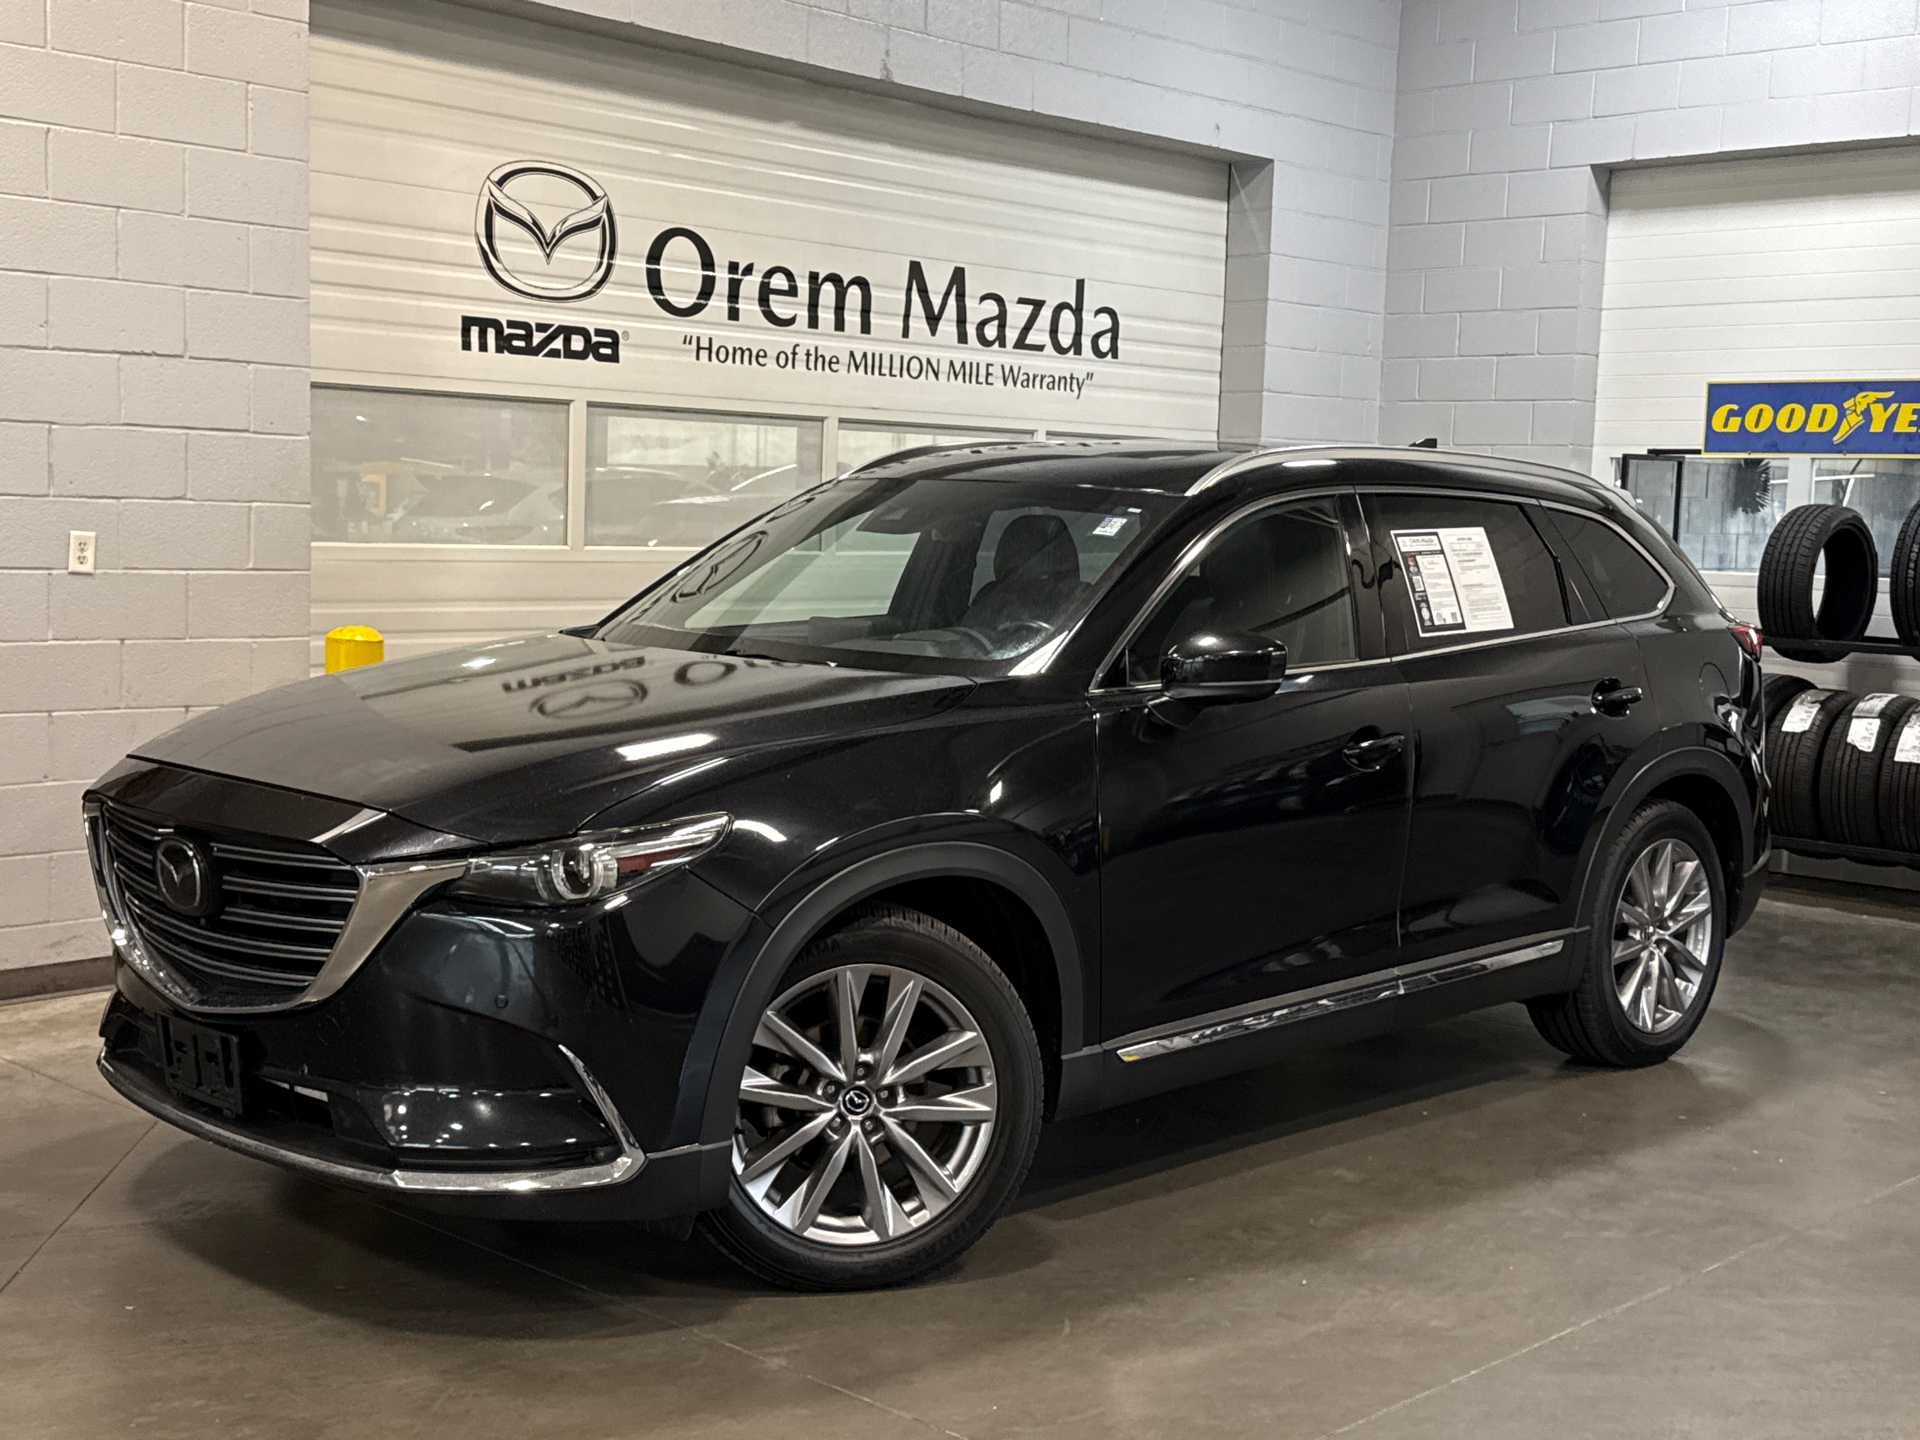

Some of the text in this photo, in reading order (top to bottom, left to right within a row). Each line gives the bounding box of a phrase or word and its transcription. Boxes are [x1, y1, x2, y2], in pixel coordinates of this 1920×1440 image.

[645, 227, 1120, 359] Orem Mazda
[776, 344, 800, 369] of
[805, 346, 840, 373] the
[847, 350, 940, 382] MILLION
[947, 359, 994, 386] MILE
[1711, 403, 1920, 433] GOODYE
